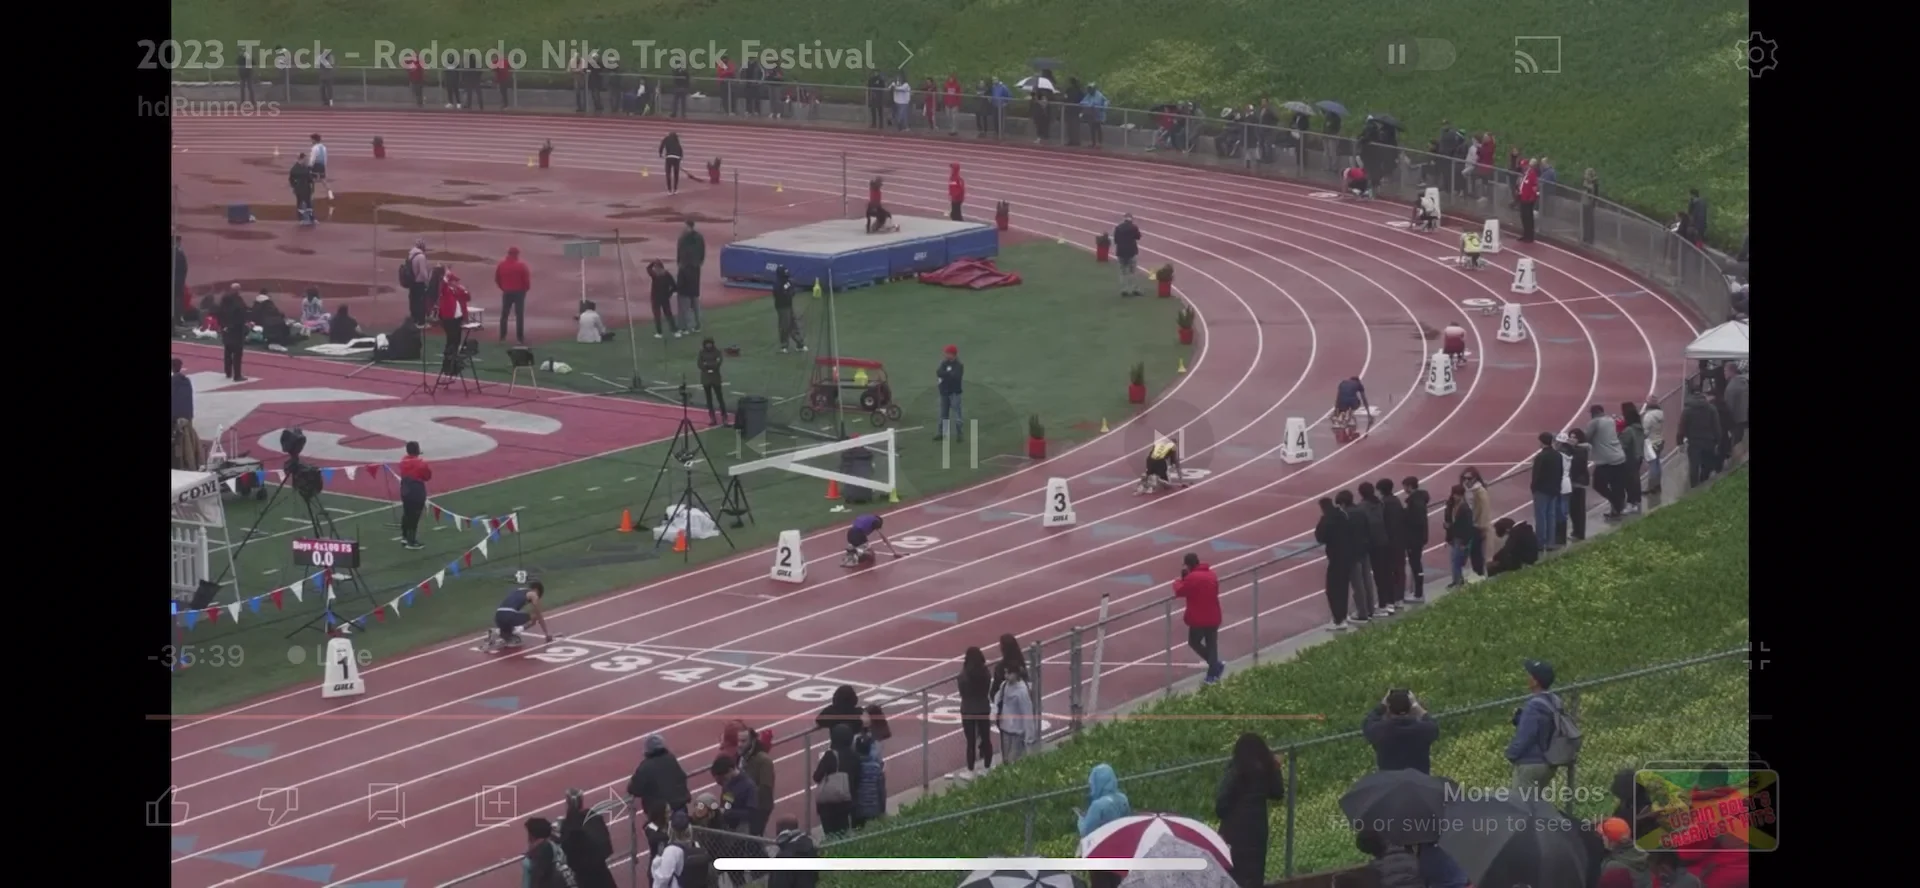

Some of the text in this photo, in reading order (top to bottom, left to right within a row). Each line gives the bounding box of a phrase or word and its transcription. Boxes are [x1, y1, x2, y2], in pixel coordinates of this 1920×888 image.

[1484, 229, 1493, 243] 8
[1518, 268, 1525, 283] 7
[1503, 315, 1510, 331] 6
[1430, 364, 1451, 382] 5 5
[1296, 431, 1306, 448] 4
[1054, 492, 1066, 512] 3
[312, 551, 334, 567] 0.0
[780, 546, 792, 567] 2
[337, 656, 349, 680] 1
[523, 646, 589, 663] 2
[590, 655, 653, 673] 3
[656, 667, 715, 683] 4
[718, 673, 784, 692] 5
